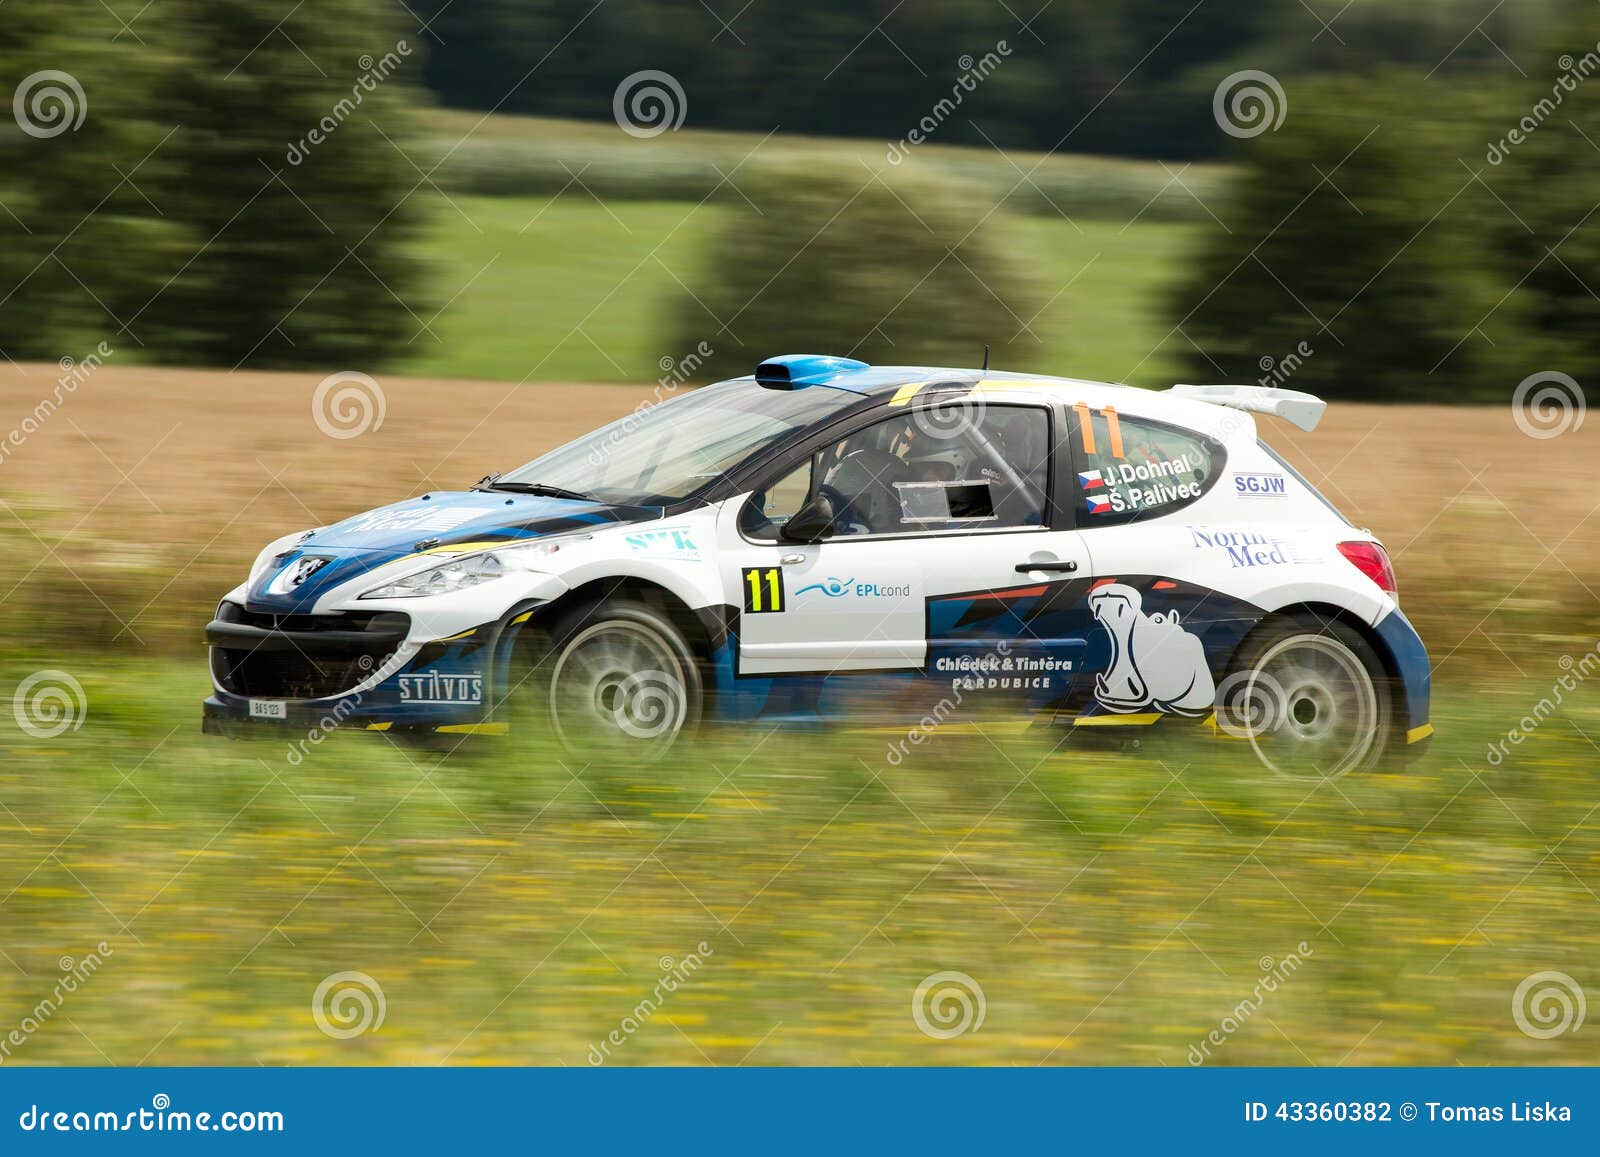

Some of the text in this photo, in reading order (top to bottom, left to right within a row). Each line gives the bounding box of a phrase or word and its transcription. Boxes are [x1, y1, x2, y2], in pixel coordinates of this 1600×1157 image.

[1072, 401, 1125, 459] 11
[1104, 454, 1192, 487] J.Dohnal
[1109, 481, 1202, 512] Š.Palivec
[1235, 477, 1285, 493] SGJW
[1226, 544, 1288, 569] Med
[747, 569, 780, 611] 11
[856, 584, 910, 597] EPLcond
[952, 677, 1050, 689] PARDUBICE
